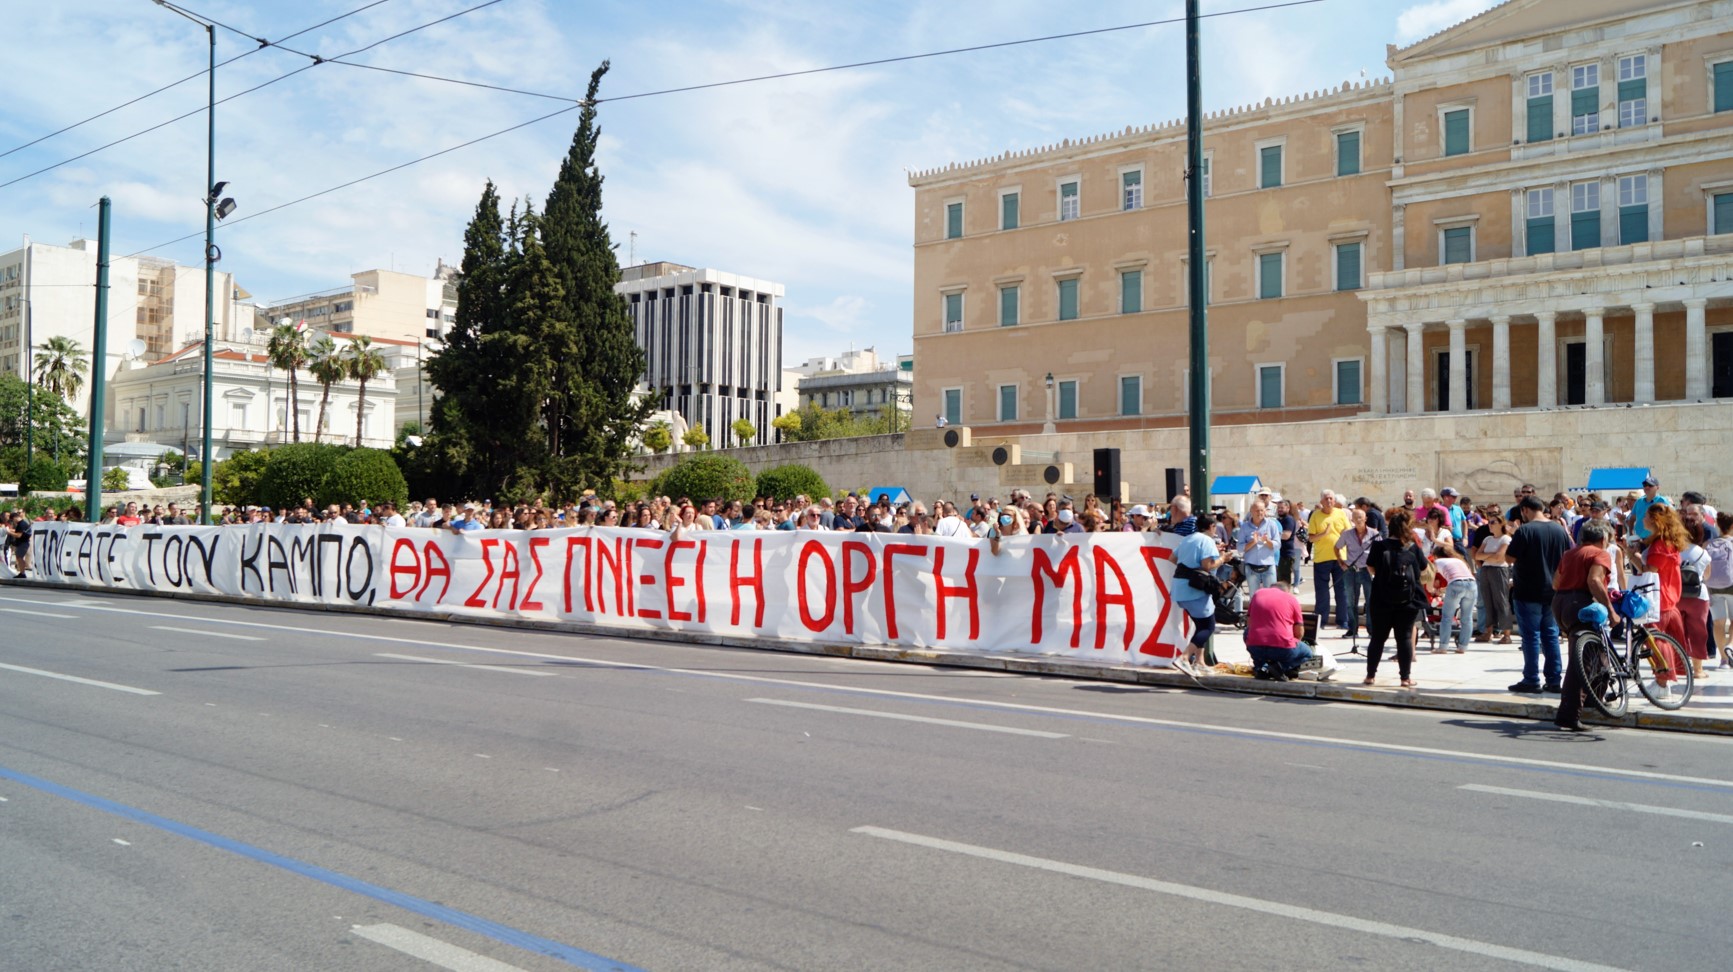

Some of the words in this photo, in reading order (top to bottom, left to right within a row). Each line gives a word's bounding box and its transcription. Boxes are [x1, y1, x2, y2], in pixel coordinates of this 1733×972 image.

[33, 529, 128, 582] ΠΝΙΞΑΤΕ
[142, 533, 220, 588] ΤΟΝ
[240, 532, 377, 606] ΚΑΜΠΟ,
[389, 537, 451, 604] ΘΑ
[464, 537, 550, 611] ΣΑΣ
[564, 536, 707, 624] ΠΝΙΞΕΙ
[729, 537, 765, 628] Η
[797, 539, 980, 641] ΟΡΓΗ
